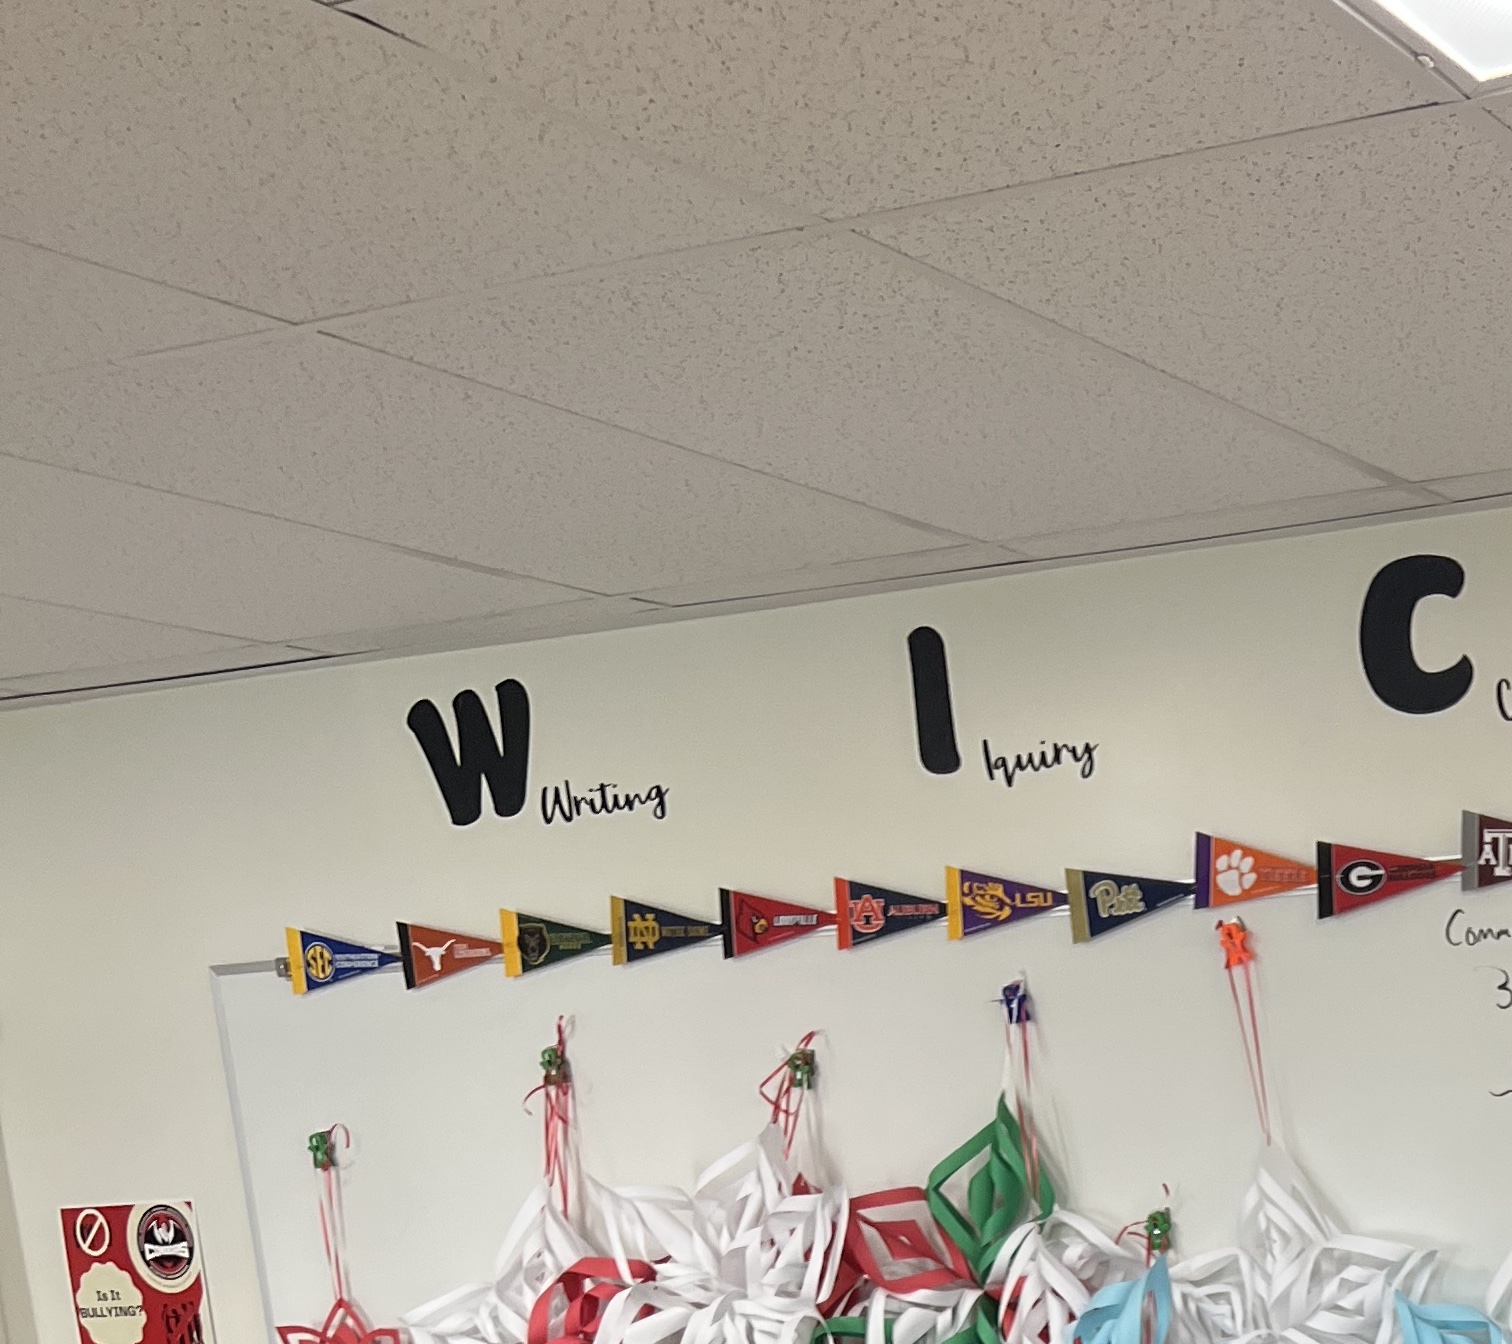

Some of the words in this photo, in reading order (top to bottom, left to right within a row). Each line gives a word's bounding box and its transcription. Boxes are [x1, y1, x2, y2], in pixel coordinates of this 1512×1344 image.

[1360, 555, 1473, 714] C
[908, 626, 960, 774] I
[407, 679, 530, 826] W
[541, 781, 670, 825] Writing
[1012, 891, 1053, 908] LSU
[80, 1304, 143, 1319] BULLYING?
